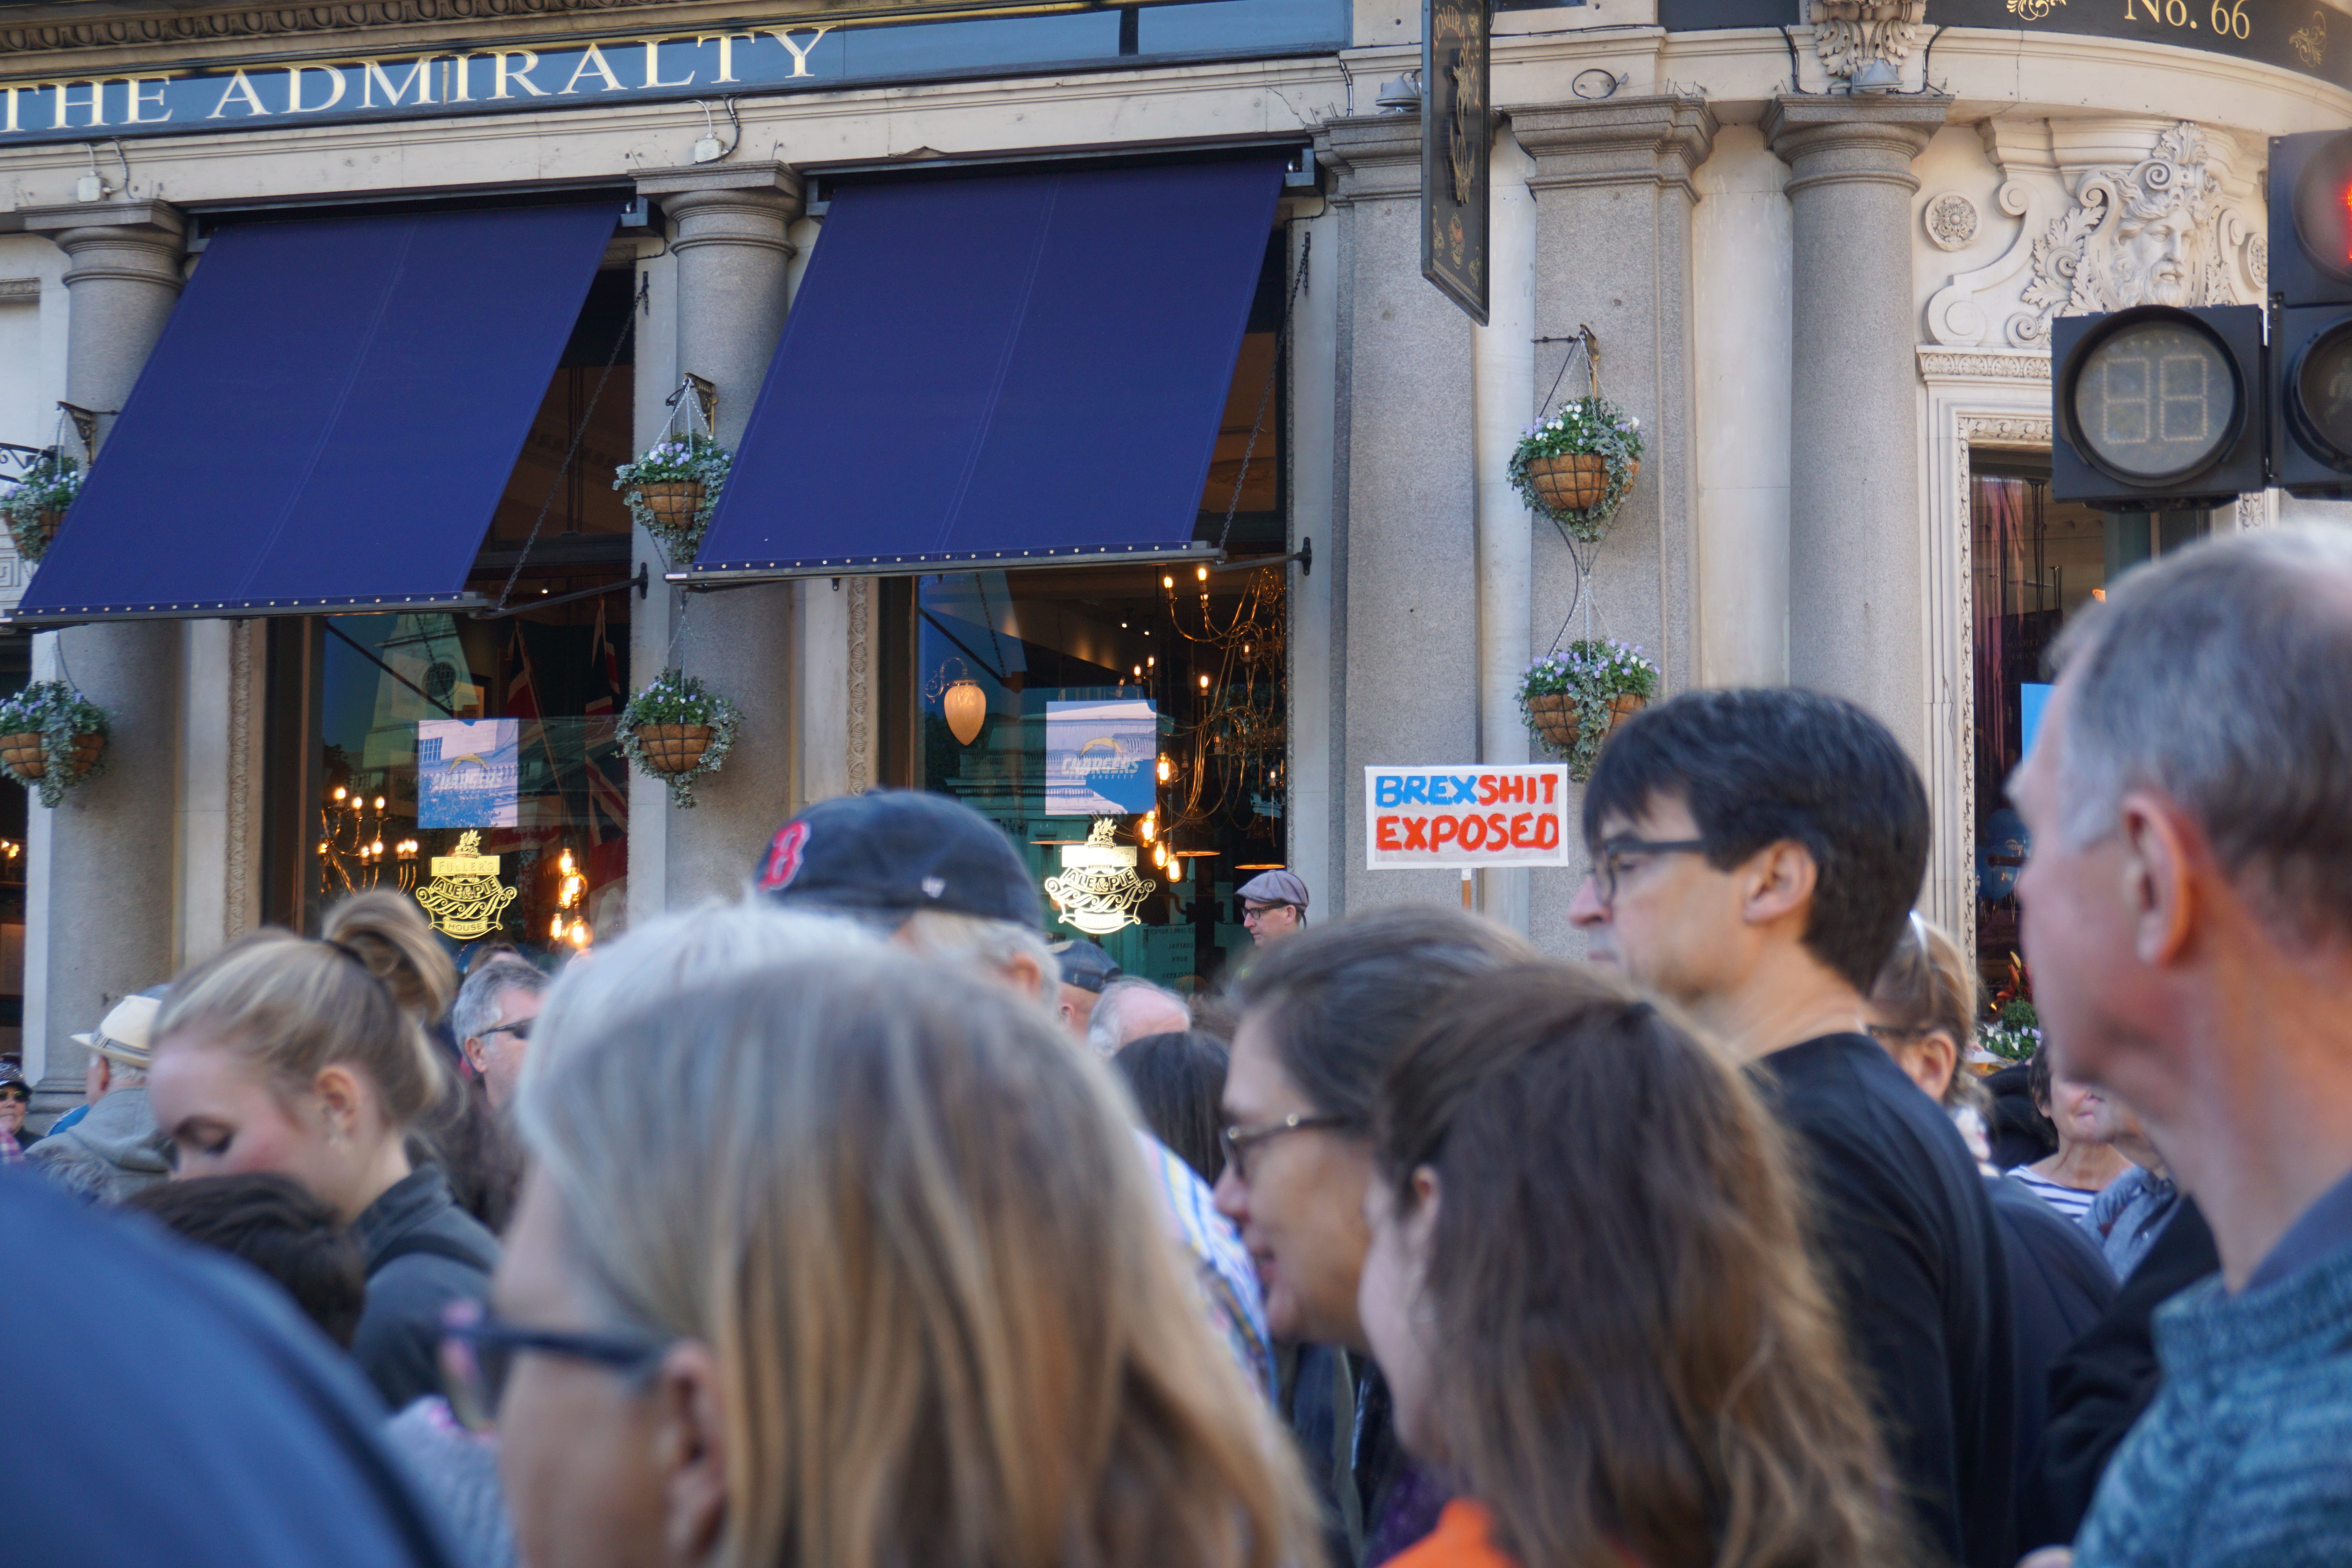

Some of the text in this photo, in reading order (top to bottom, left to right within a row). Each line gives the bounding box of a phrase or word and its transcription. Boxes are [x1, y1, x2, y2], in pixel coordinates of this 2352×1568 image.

[2124, 0, 2250, 39] No. 66
[0, 25, 837, 132] THE ADMIRALTY
[1061, 757, 1140, 775] CHARGERS
[1375, 774, 1558, 808] BREXSHIT
[1376, 812, 1559, 852] EXPOSED
[438, 860, 493, 872] FULLER'S
[448, 923, 483, 931] HOUSE
